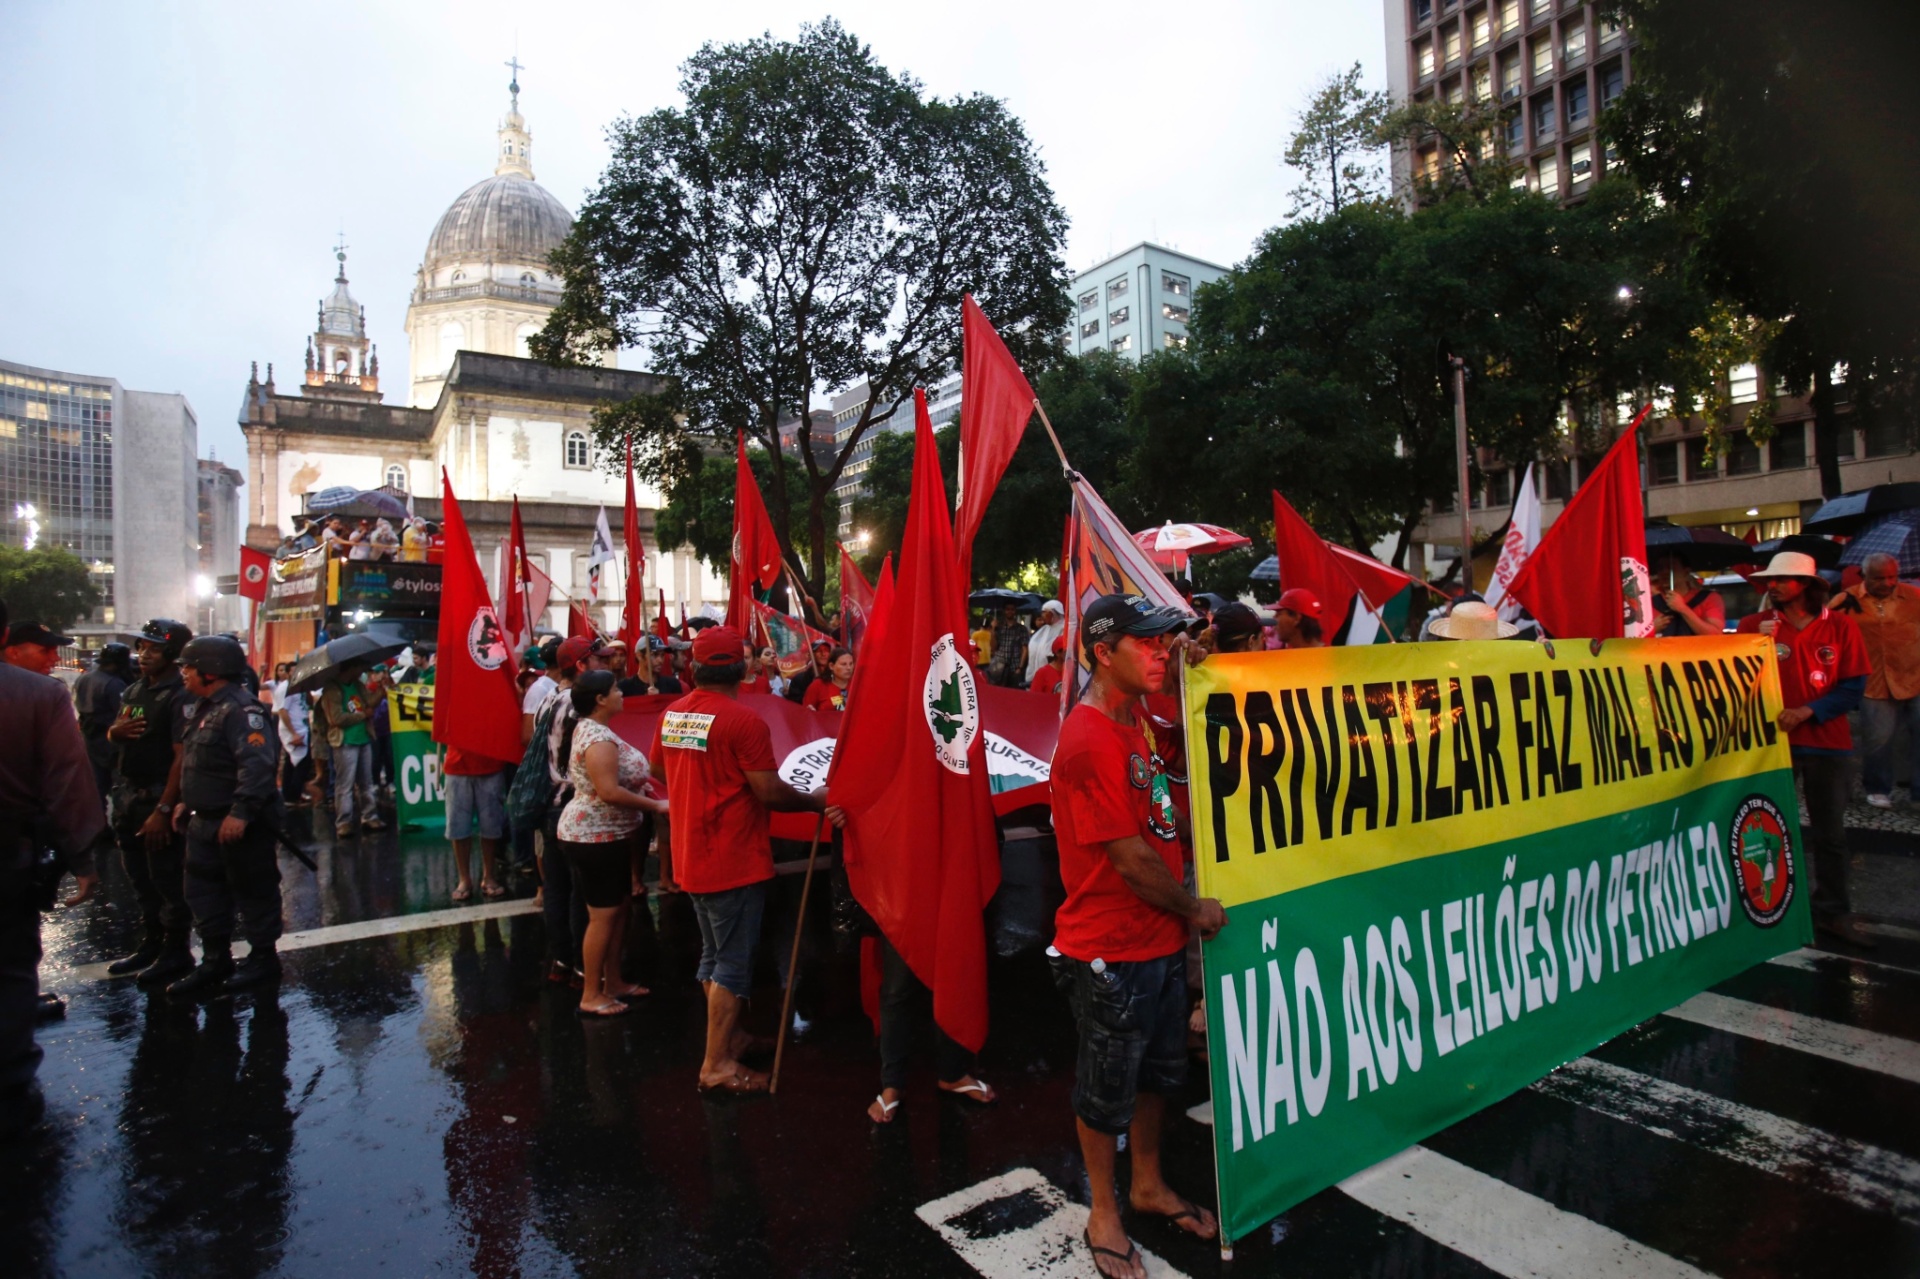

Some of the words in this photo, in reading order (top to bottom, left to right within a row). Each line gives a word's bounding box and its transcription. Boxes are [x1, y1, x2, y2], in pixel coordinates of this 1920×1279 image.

[392, 577, 443, 593] Stylos
[931, 642, 946, 665] RES
[396, 694, 435, 721] LE
[960, 672, 975, 711] TERRA
[1205, 675, 1510, 863] PRIVATIZAR
[1509, 669, 1583, 801] FAZ
[1578, 666, 1653, 786] MAL
[1644, 661, 1693, 772] AO
[1681, 655, 1777, 762] BRASIL
[401, 754, 446, 805] CR
[1748, 799, 1762, 809] TEM
[1763, 801, 1776, 816] QUE
[1221, 917, 1331, 1153] NÃO
[1342, 915, 1422, 1101] AOS
[1421, 854, 1558, 1057] LEILÕES
[1562, 860, 1602, 993] DO
[1605, 807, 1731, 973] PETRÓLEO
